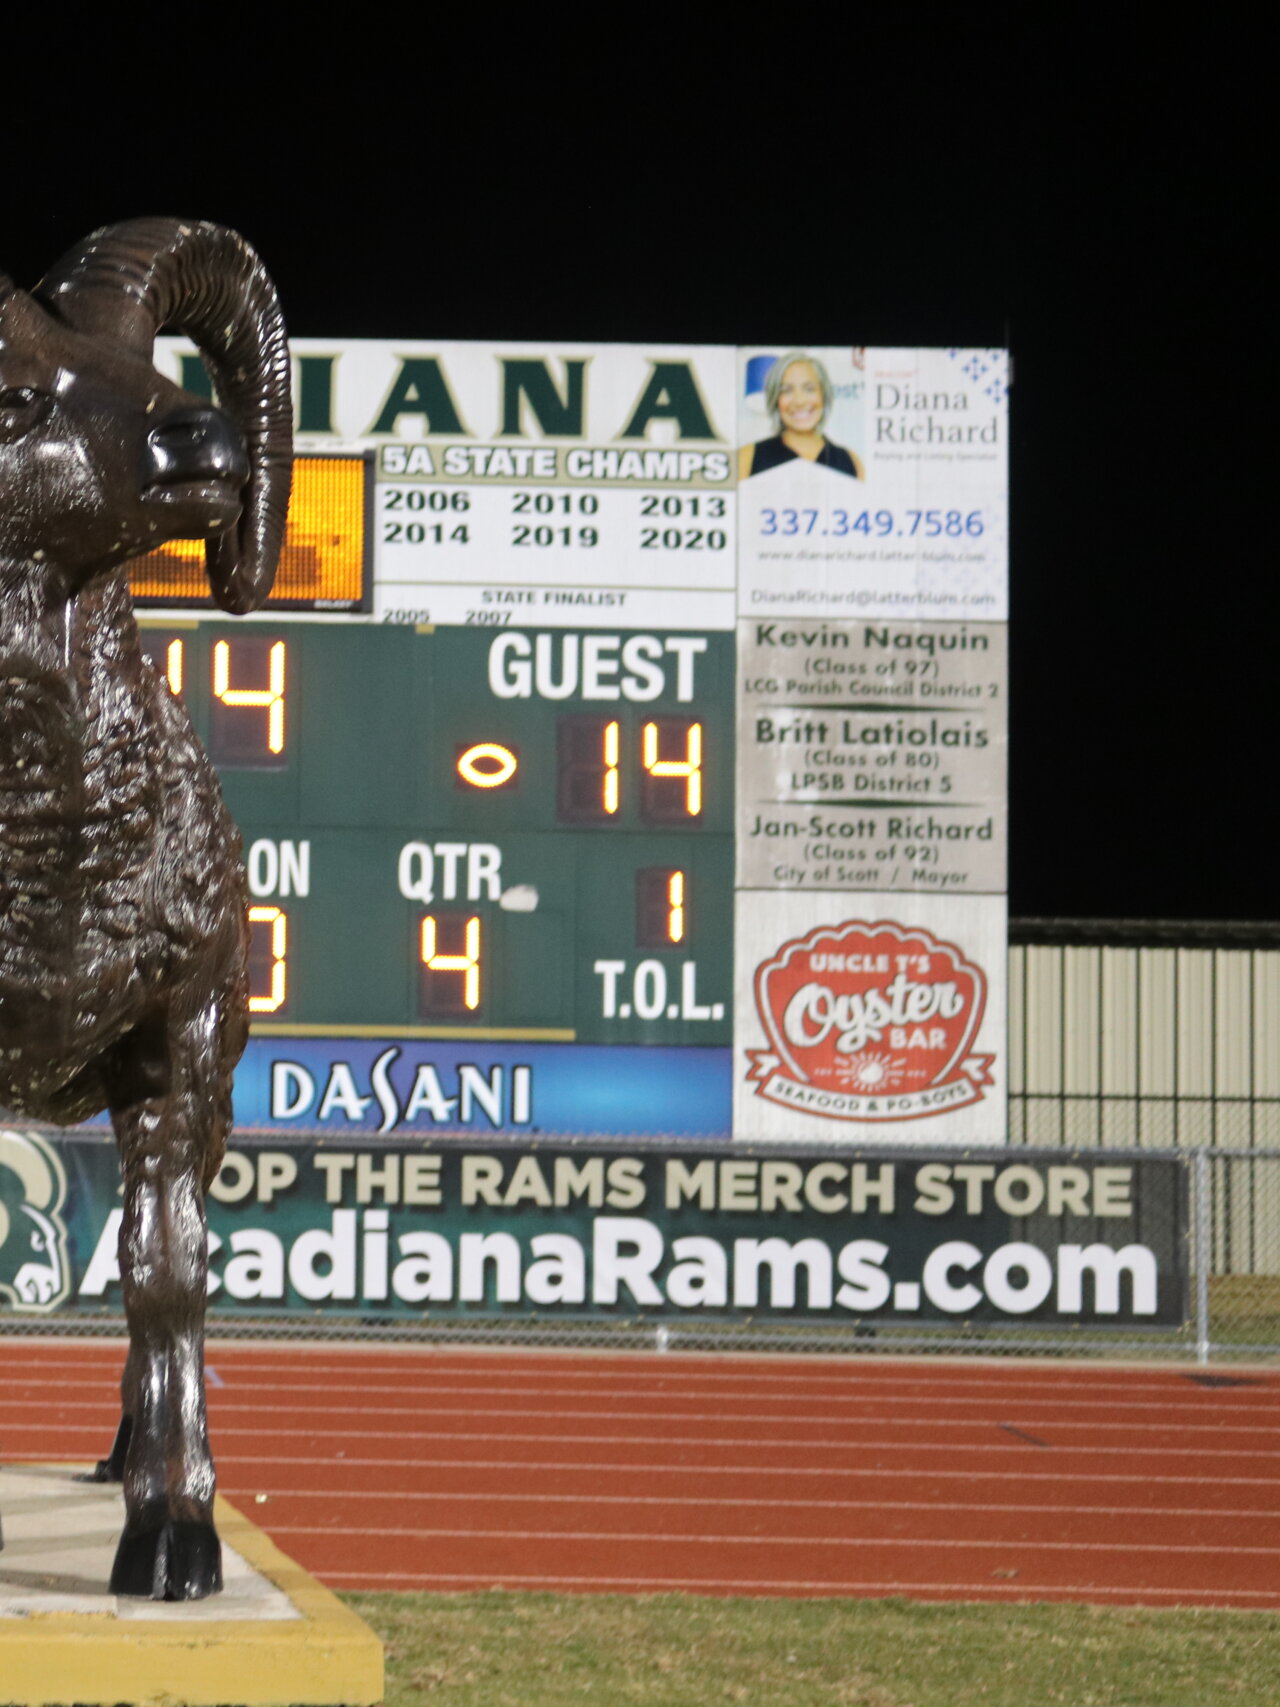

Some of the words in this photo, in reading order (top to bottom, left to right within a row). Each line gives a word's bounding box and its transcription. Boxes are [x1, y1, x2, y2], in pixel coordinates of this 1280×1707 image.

[874, 383, 968, 412] Diana
[874, 416, 998, 444] Richard
[381, 446, 435, 475] 5A
[443, 447, 558, 479] STATE
[566, 450, 730, 481] CHAMPS
[383, 490, 471, 513] 2006
[511, 492, 600, 516] 2010
[639, 495, 727, 518] 2013
[760, 508, 984, 537] 337.349.7586
[383, 523, 471, 545] 2014
[511, 525, 600, 548] 2019
[639, 528, 727, 551] 2020
[481, 590, 536, 605] STATE
[543, 591, 628, 607] FINALIST
[382, 608, 430, 625] 2005
[464, 609, 513, 626] 2007
[756, 624, 849, 649] Kevin
[864, 627, 989, 656] Naquin
[487, 632, 708, 701] GUEST
[804, 657, 866, 676] (Class
[875, 659, 897, 675] of
[904, 659, 940, 678] 97)
[745, 679, 778, 694] LCG
[786, 679, 841, 695] Parish
[849, 680, 914, 696] Council
[921, 682, 981, 697] District
[988, 684, 999, 698] 2
[755, 719, 828, 744] Britt
[843, 719, 989, 747] Latiolais
[604, 720, 703, 816] 14
[804, 749, 866, 768] (Class
[875, 750, 897, 767] of
[905, 751, 940, 770] 80)
[791, 773, 844, 792] LPSB
[854, 773, 931, 793] District
[939, 775, 952, 793] 5
[749, 815, 877, 839] Jan-Scott
[887, 817, 994, 841] Richard
[803, 843, 866, 862] (Class
[875, 844, 895, 861] of
[904, 845, 940, 864] 92)
[397, 842, 503, 904] QTR
[773, 865, 807, 883] City
[813, 866, 831, 882] of
[836, 866, 879, 882] Scott
[912, 869, 969, 888] Mayor
[669, 870, 684, 943] 1
[421, 915, 481, 1010] 4
[809, 953, 889, 974] UNCLE
[896, 954, 931, 974] T'S
[594, 960, 724, 1020] T.O.L.
[783, 973, 965, 1055] Oyster
[889, 1027, 948, 1050] BAR
[270, 1046, 533, 1135] DASANI
[774, 1081, 860, 1111] SEAFOOD
[867, 1101, 879, 1112] &
[314, 1154, 442, 1206] THE
[461, 1156, 646, 1209] RAMS
[665, 1159, 895, 1214] MERCH
[914, 1164, 1133, 1218] STORE
